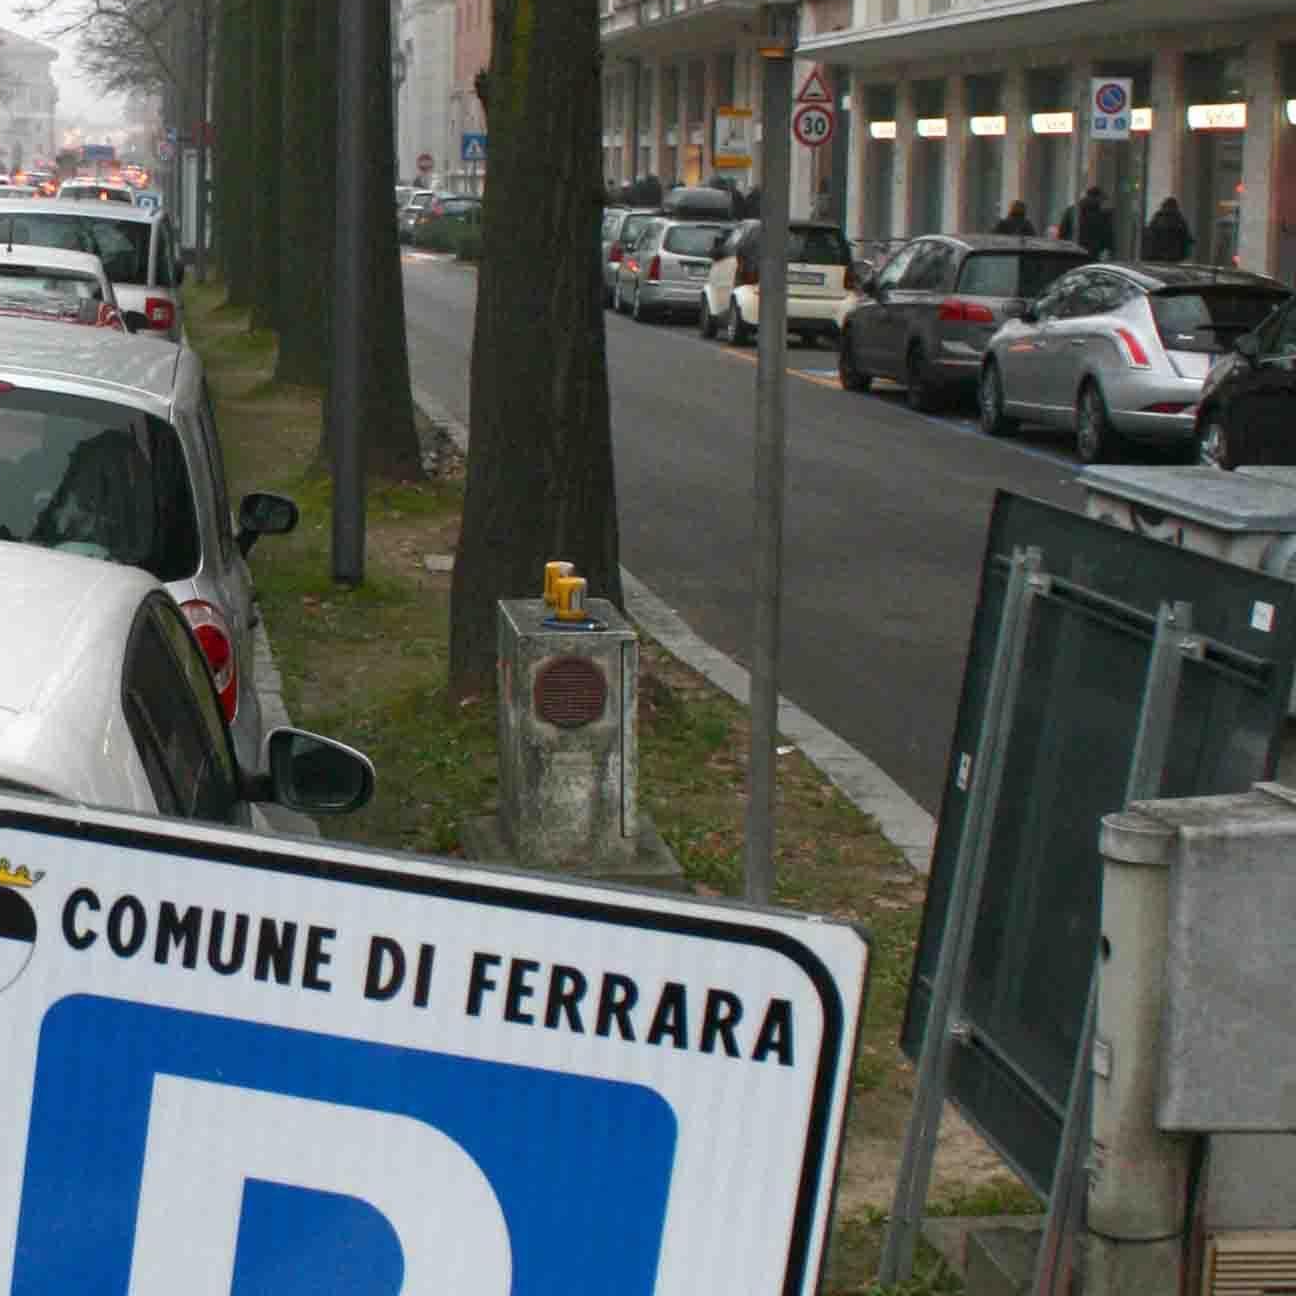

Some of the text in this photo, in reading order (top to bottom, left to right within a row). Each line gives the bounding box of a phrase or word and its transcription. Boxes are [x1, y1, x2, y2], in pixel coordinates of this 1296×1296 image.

[804, 116, 826, 135] 30
[61, 887, 795, 1067] COMUNE DI FERRARA
